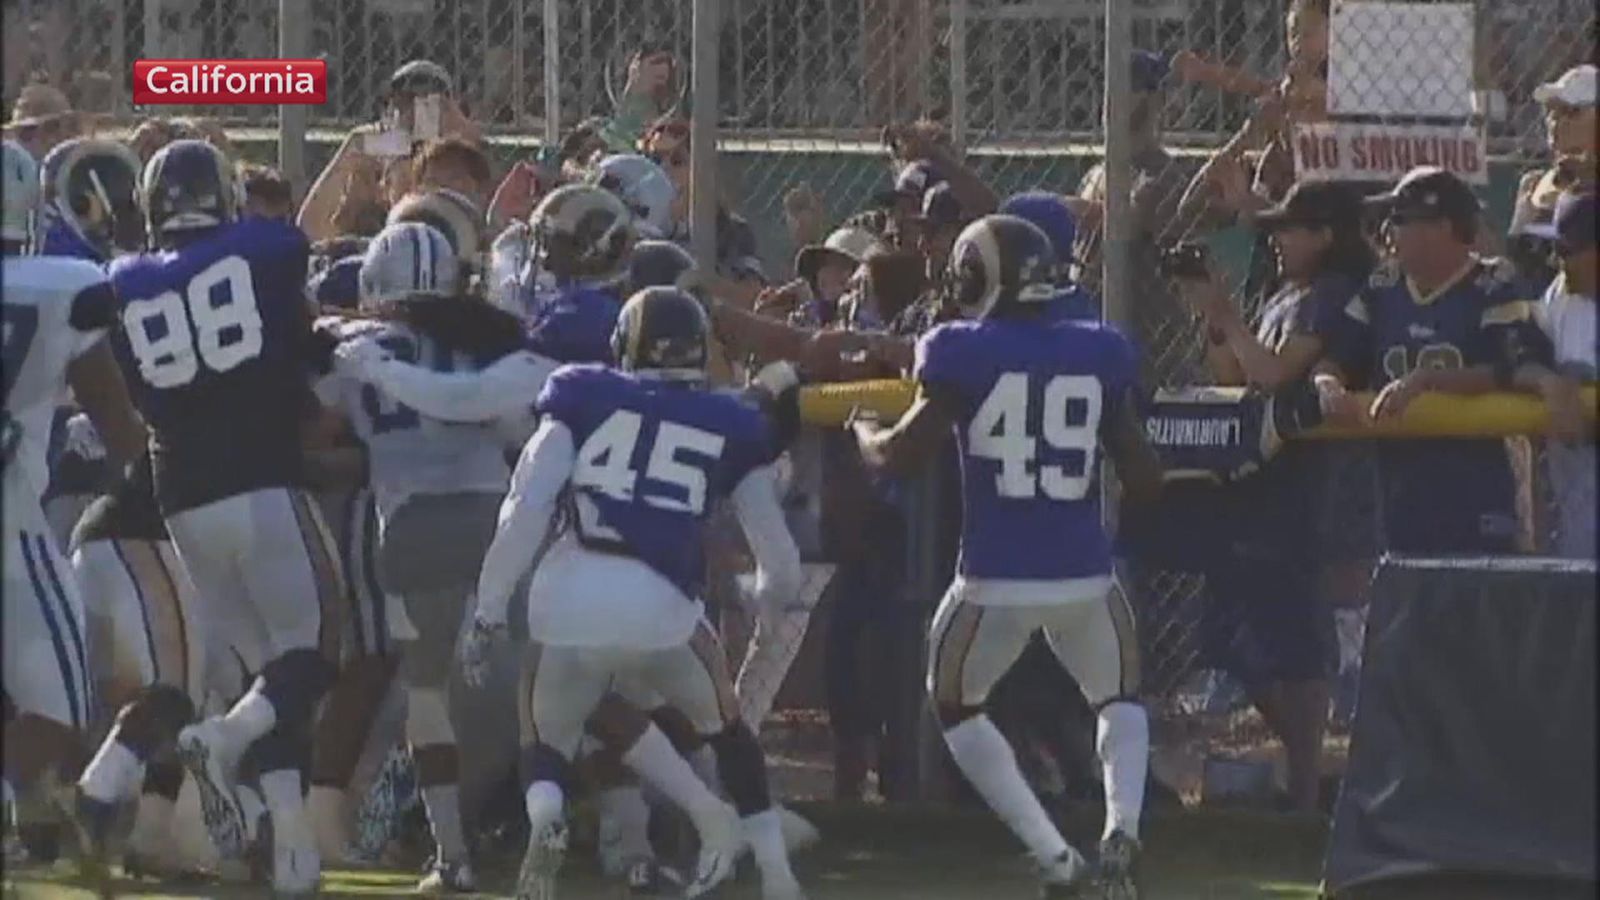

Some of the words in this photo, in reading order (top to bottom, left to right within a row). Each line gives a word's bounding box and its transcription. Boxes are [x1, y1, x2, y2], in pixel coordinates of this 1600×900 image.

[1298, 135, 1338, 170] NO
[1351, 135, 1478, 173] SMOKING
[123, 254, 263, 389] 98
[573, 408, 726, 516] 45
[968, 371, 1102, 500] 49
